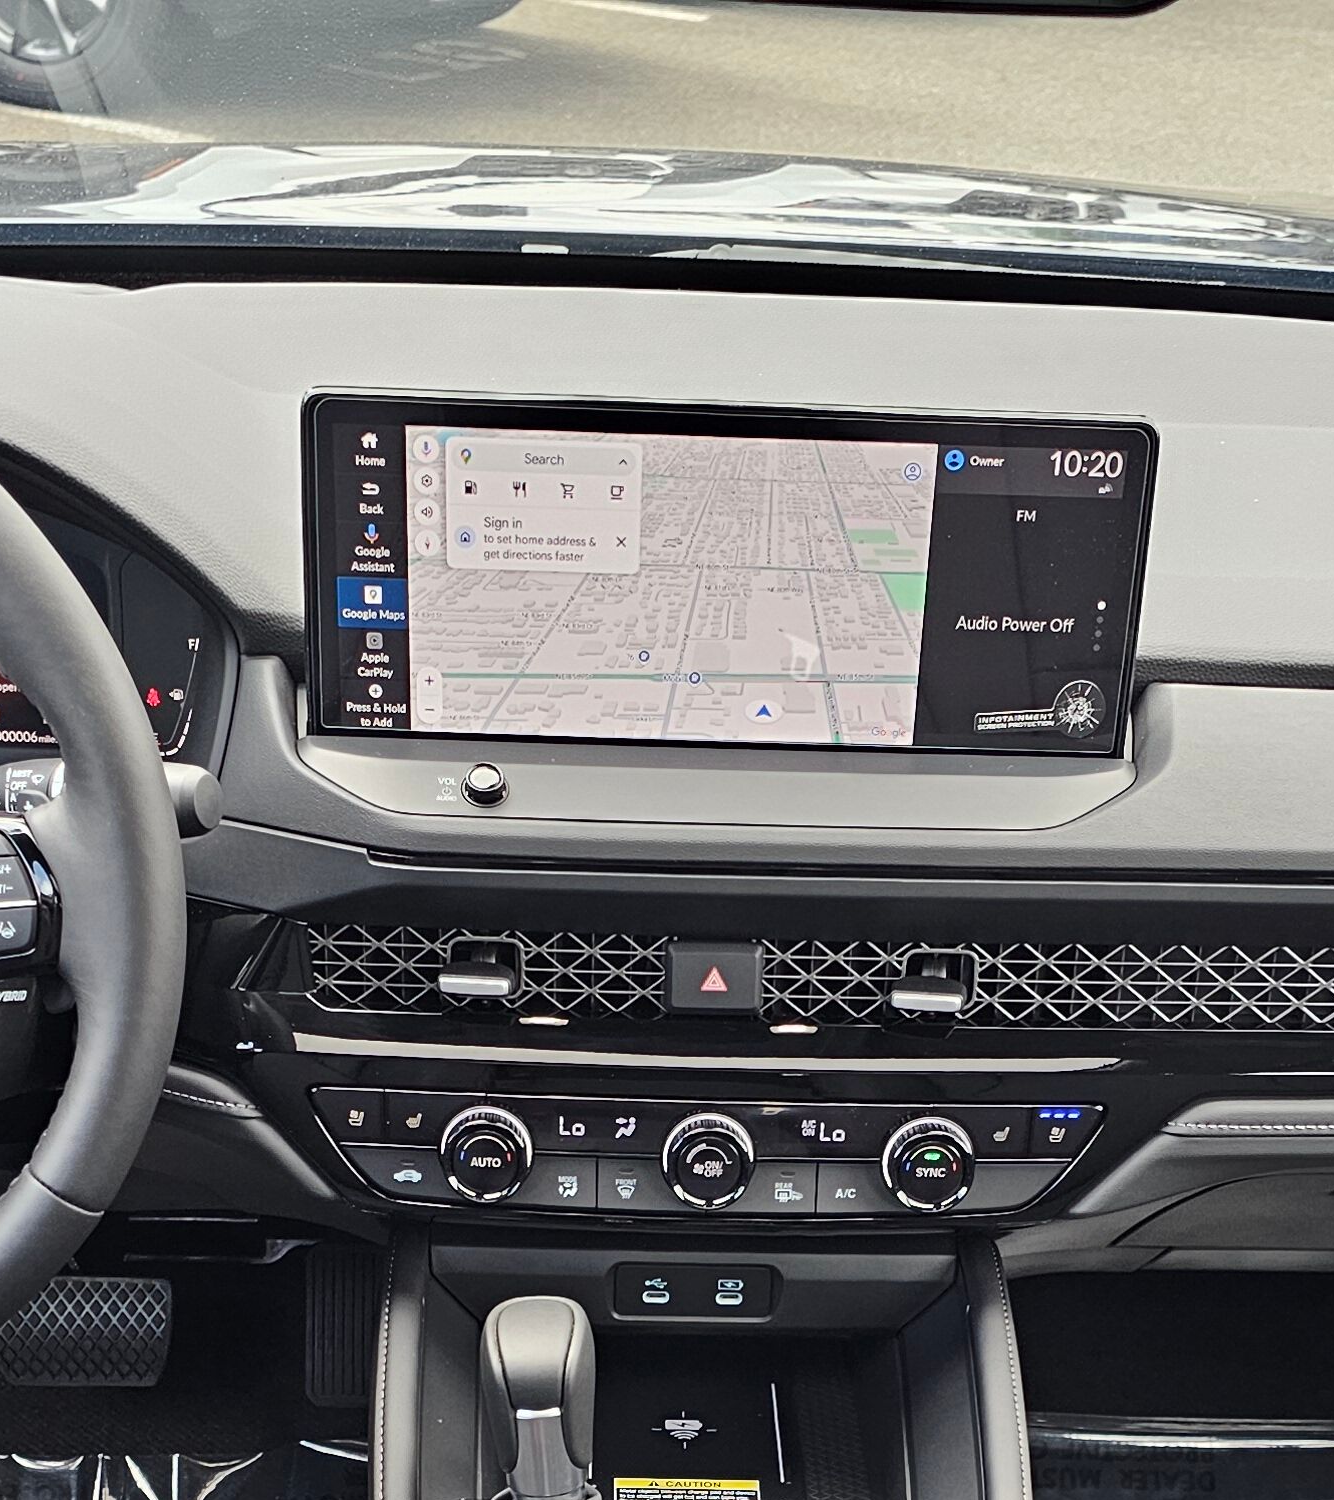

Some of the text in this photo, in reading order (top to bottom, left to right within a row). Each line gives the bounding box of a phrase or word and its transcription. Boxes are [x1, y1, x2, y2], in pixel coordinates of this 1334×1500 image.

[355, 455, 386, 467] Home
[524, 453, 565, 466] Search
[969, 455, 1005, 467] Owner
[1050, 450, 1124, 478] 10:20
[359, 503, 384, 515] Back
[1016, 509, 1037, 522] FM
[483, 516, 523, 530] Sign in
[483, 534, 597, 547] to set home address &
[355, 546, 390, 560] Google
[483, 549, 585, 562] get directions faster
[351, 560, 395, 574] Assistant
[342, 609, 377, 622] Google
[379, 609, 406, 622] Maps
[955, 615, 1075, 634] Audio Power Off
[361, 653, 390, 665] Apple
[357, 667, 394, 680] CarPlay
[346, 702, 407, 714] Press & Hold
[360, 716, 393, 728] to Add
[978, 712, 1054, 724] INFOTAINMENT
[871, 726, 907, 739] Gogle
[10, 780, 28, 791] OFF
[437, 777, 457, 786] VOL
[558, 1116, 586, 1137] Lo
[801, 1119, 817, 1129] A/C
[802, 1128, 816, 1137] ON
[819, 1121, 846, 1142] Lo
[470, 1156, 502, 1169] AUTO
[704, 1160, 724, 1170] ON/
[704, 1169, 724, 1178] OFF
[915, 1167, 946, 1179] SYNC
[835, 1187, 857, 1200] A/C
[665, 1480, 721, 1488] CAUTION
